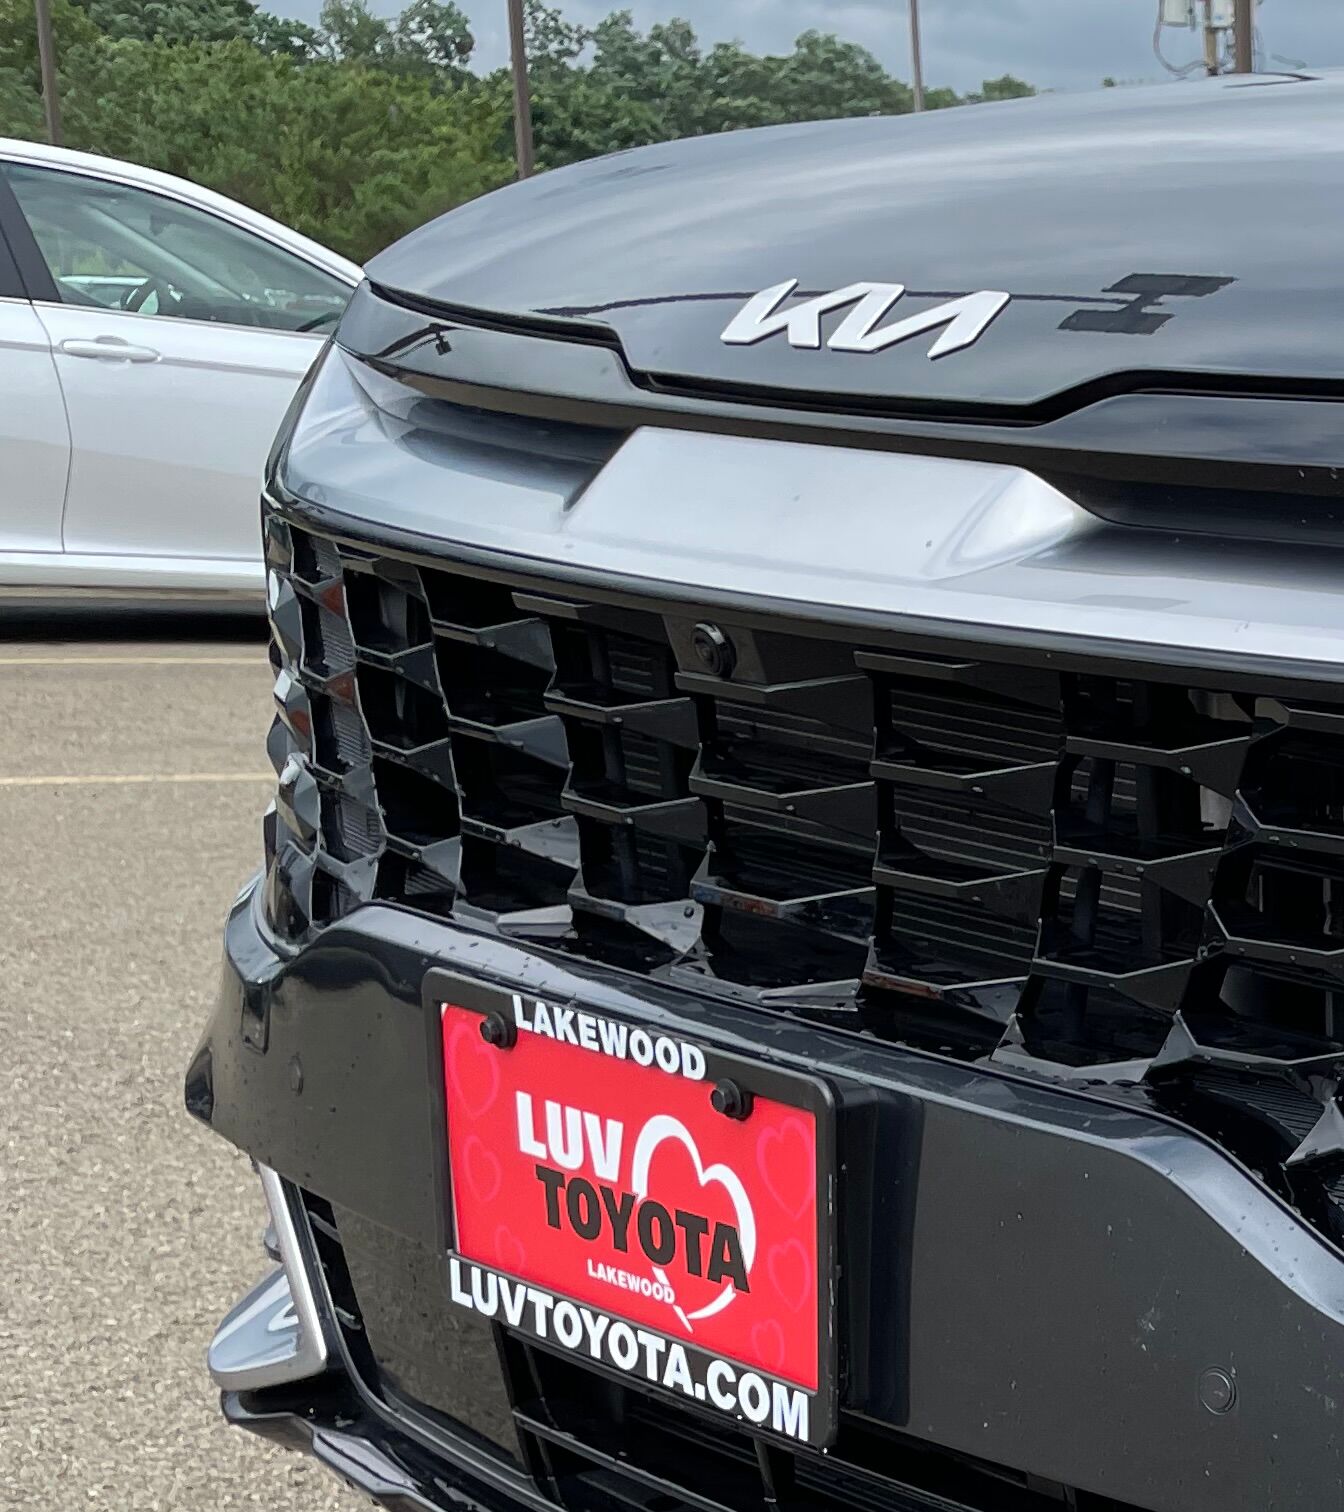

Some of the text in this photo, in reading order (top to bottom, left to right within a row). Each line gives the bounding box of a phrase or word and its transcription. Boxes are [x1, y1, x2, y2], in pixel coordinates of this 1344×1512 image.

[720, 278, 1012, 359] KIA
[512, 994, 707, 1081] LAKEWOOD
[515, 1091, 624, 1184] LUV
[535, 1164, 751, 1294] TOYOTA
[587, 1259, 676, 1304] LAKEWOOD
[449, 1257, 809, 1442] LUVTOYOTA.COM
